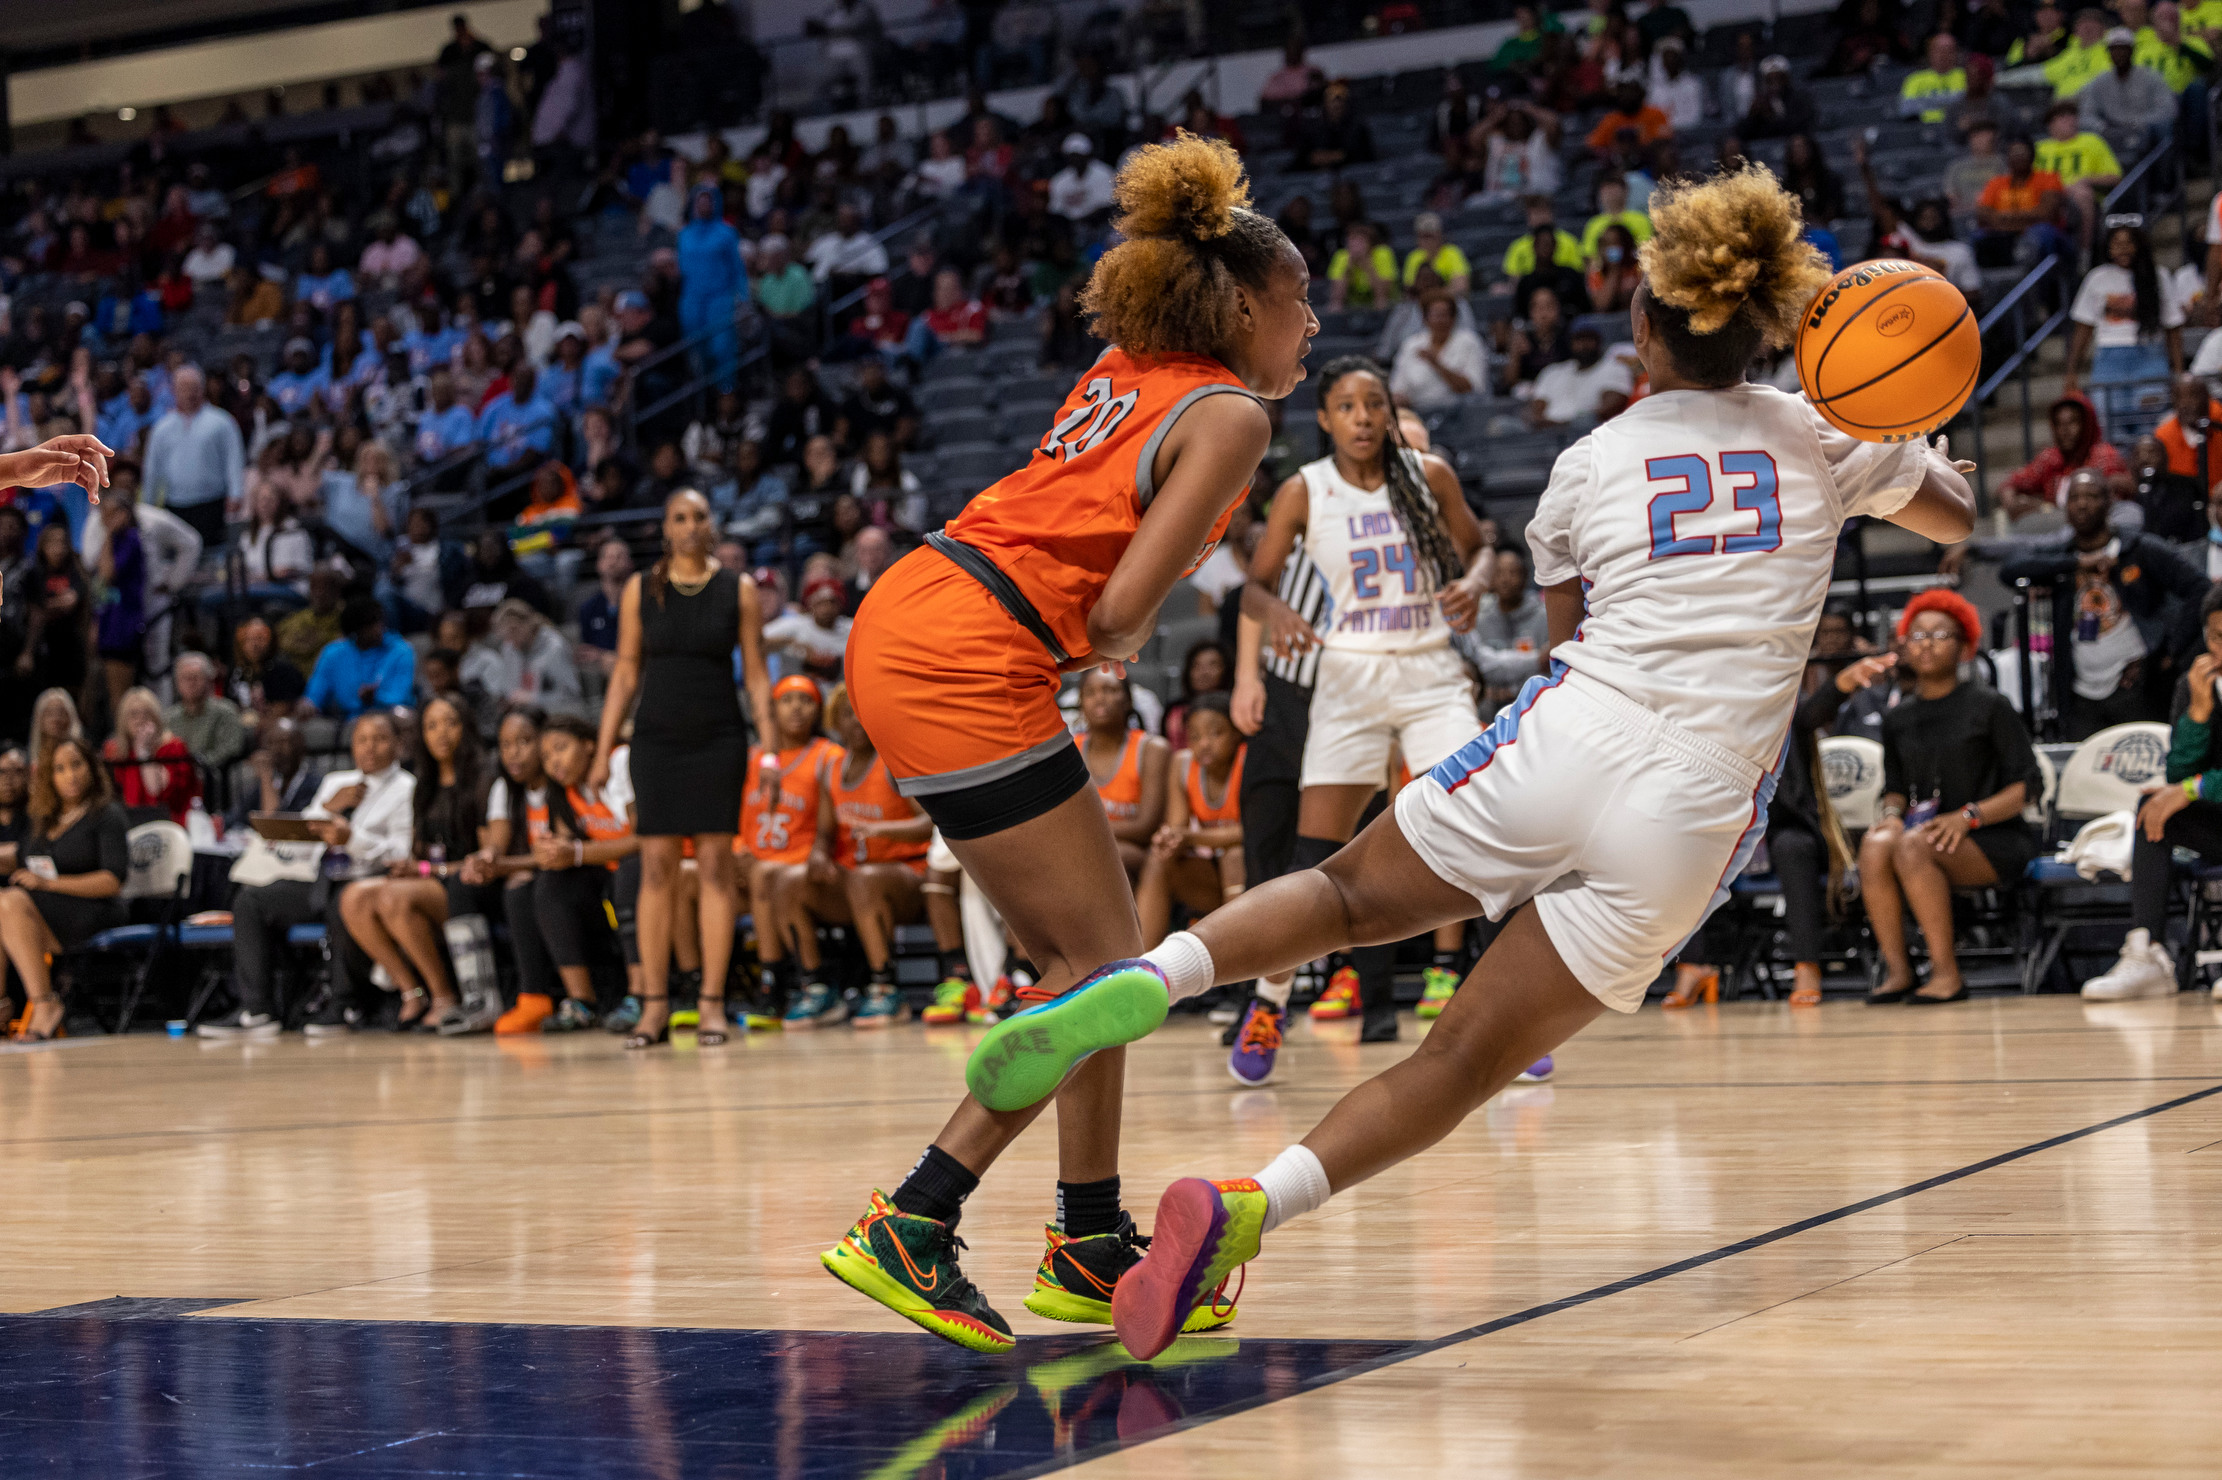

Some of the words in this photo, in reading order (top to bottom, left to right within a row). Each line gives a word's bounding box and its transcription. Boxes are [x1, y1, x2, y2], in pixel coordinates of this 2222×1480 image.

[1808, 260, 1922, 330] Wilson
[1040, 376, 1140, 464] 20
[1644, 450, 1783, 561] 23
[1349, 543, 1417, 600] 24
